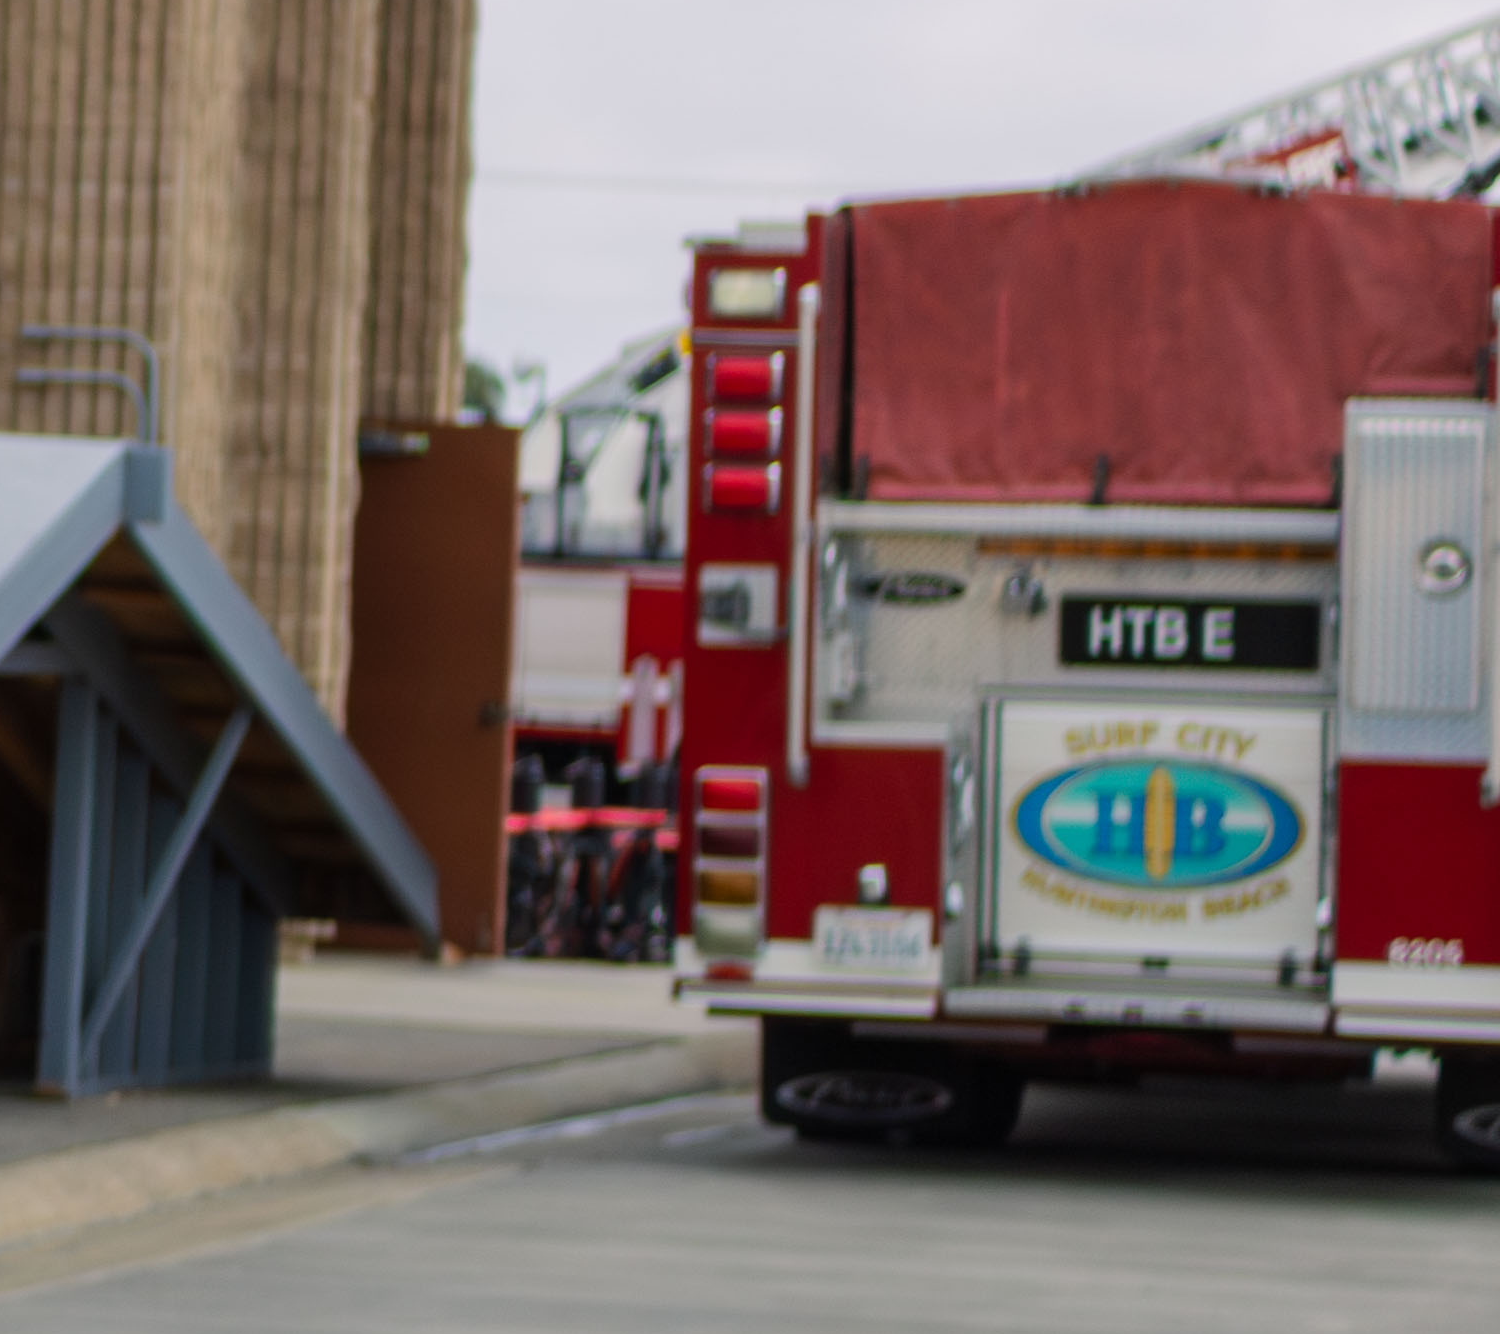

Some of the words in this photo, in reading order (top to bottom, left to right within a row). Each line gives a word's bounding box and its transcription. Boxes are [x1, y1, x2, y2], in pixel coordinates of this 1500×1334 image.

[1087, 602, 1190, 660] HTB
[1202, 605, 1237, 661] E
[1063, 718, 1160, 757] SURF
[1175, 721, 1258, 760] CITY
